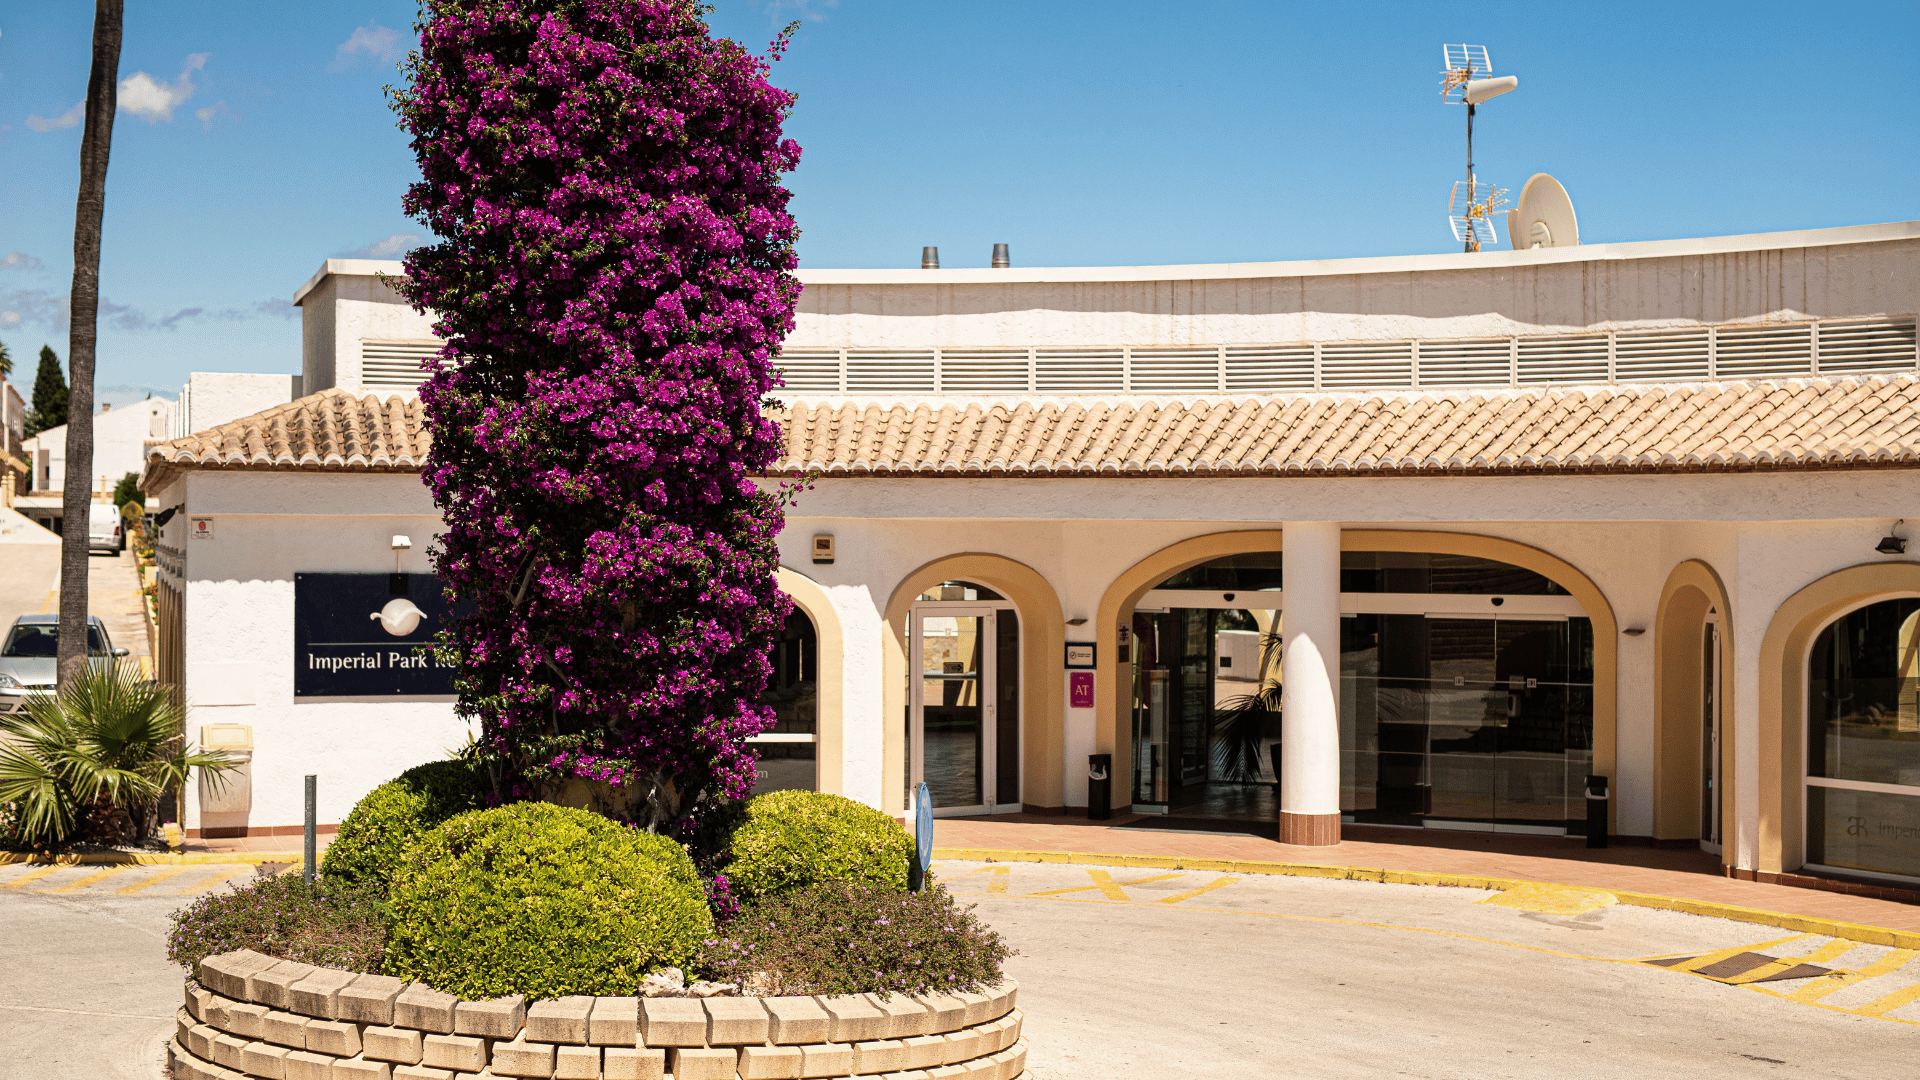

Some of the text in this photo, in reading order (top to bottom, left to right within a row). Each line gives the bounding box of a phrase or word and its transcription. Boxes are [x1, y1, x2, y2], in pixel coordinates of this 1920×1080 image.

[308, 652, 381, 673] Imperial
[388, 652, 428, 669] Park
[1075, 685, 1090, 696] AT
